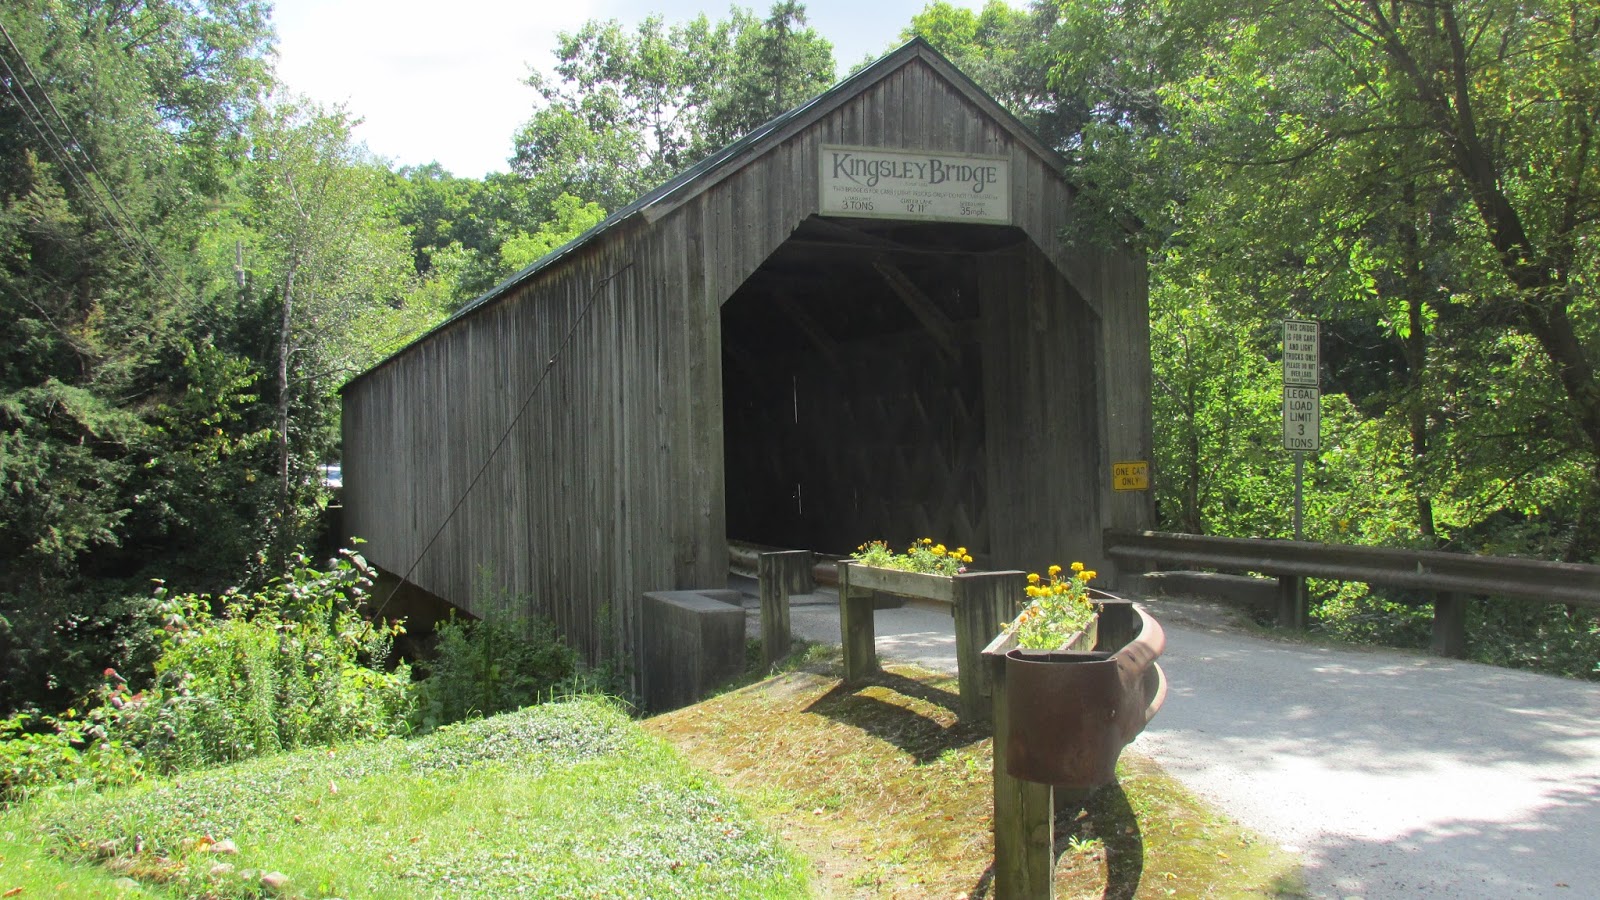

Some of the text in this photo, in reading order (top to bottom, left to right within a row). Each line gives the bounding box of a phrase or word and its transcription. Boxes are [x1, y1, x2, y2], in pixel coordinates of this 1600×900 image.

[842, 200, 874, 210] 3 TONS
[1287, 390, 1314, 399] LEGAL
[1290, 401, 1313, 410] LOAD
[1290, 412, 1312, 422] LIMIT
[1298, 424, 1304, 435] 3
[1290, 438, 1313, 448] TONS
[1122, 477, 1139, 485] ONLY
